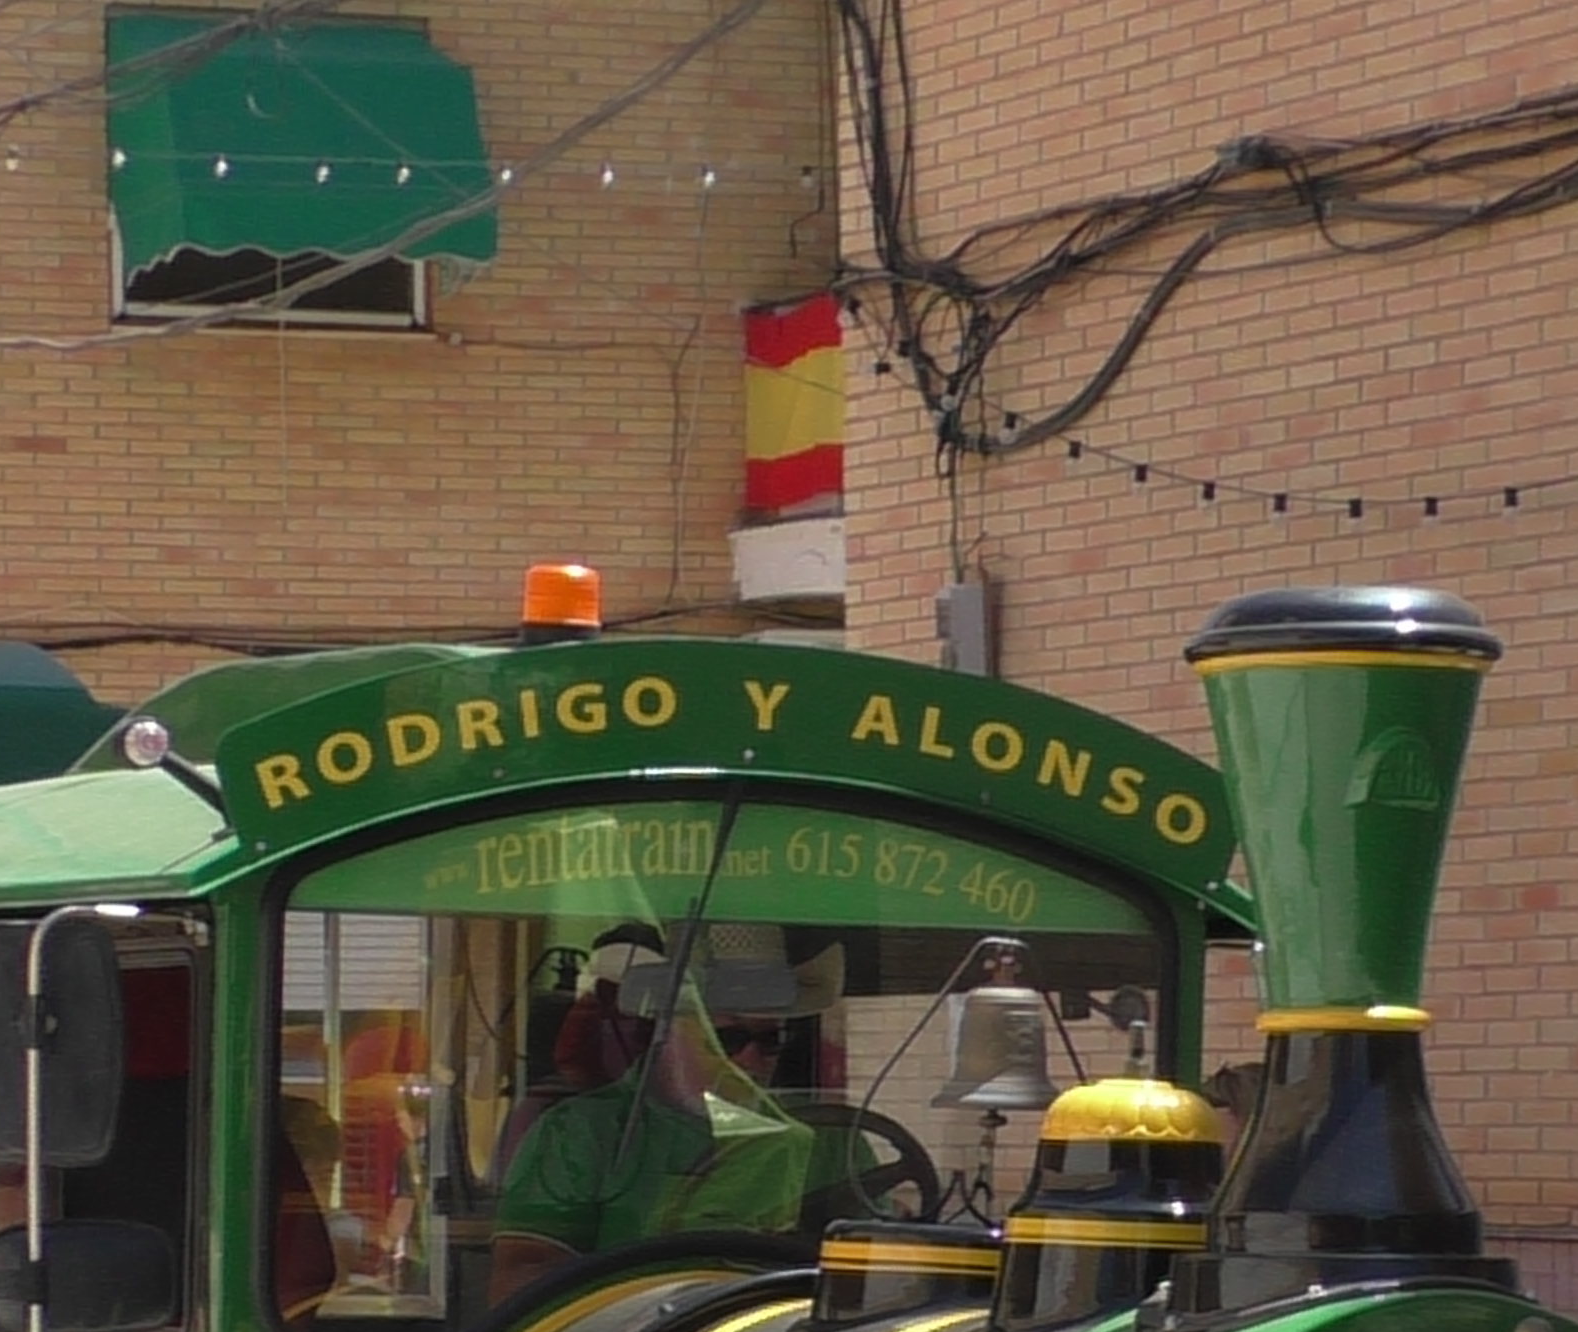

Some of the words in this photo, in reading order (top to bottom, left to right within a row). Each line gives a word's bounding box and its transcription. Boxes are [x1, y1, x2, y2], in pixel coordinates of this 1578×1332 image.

[255, 675, 677, 809] RODRIGO
[745, 680, 789, 731] Y
[851, 695, 1206, 845] ALONSO
[786, 826, 864, 878] 615
[874, 838, 949, 896] 872
[958, 861, 1037, 923] 460
